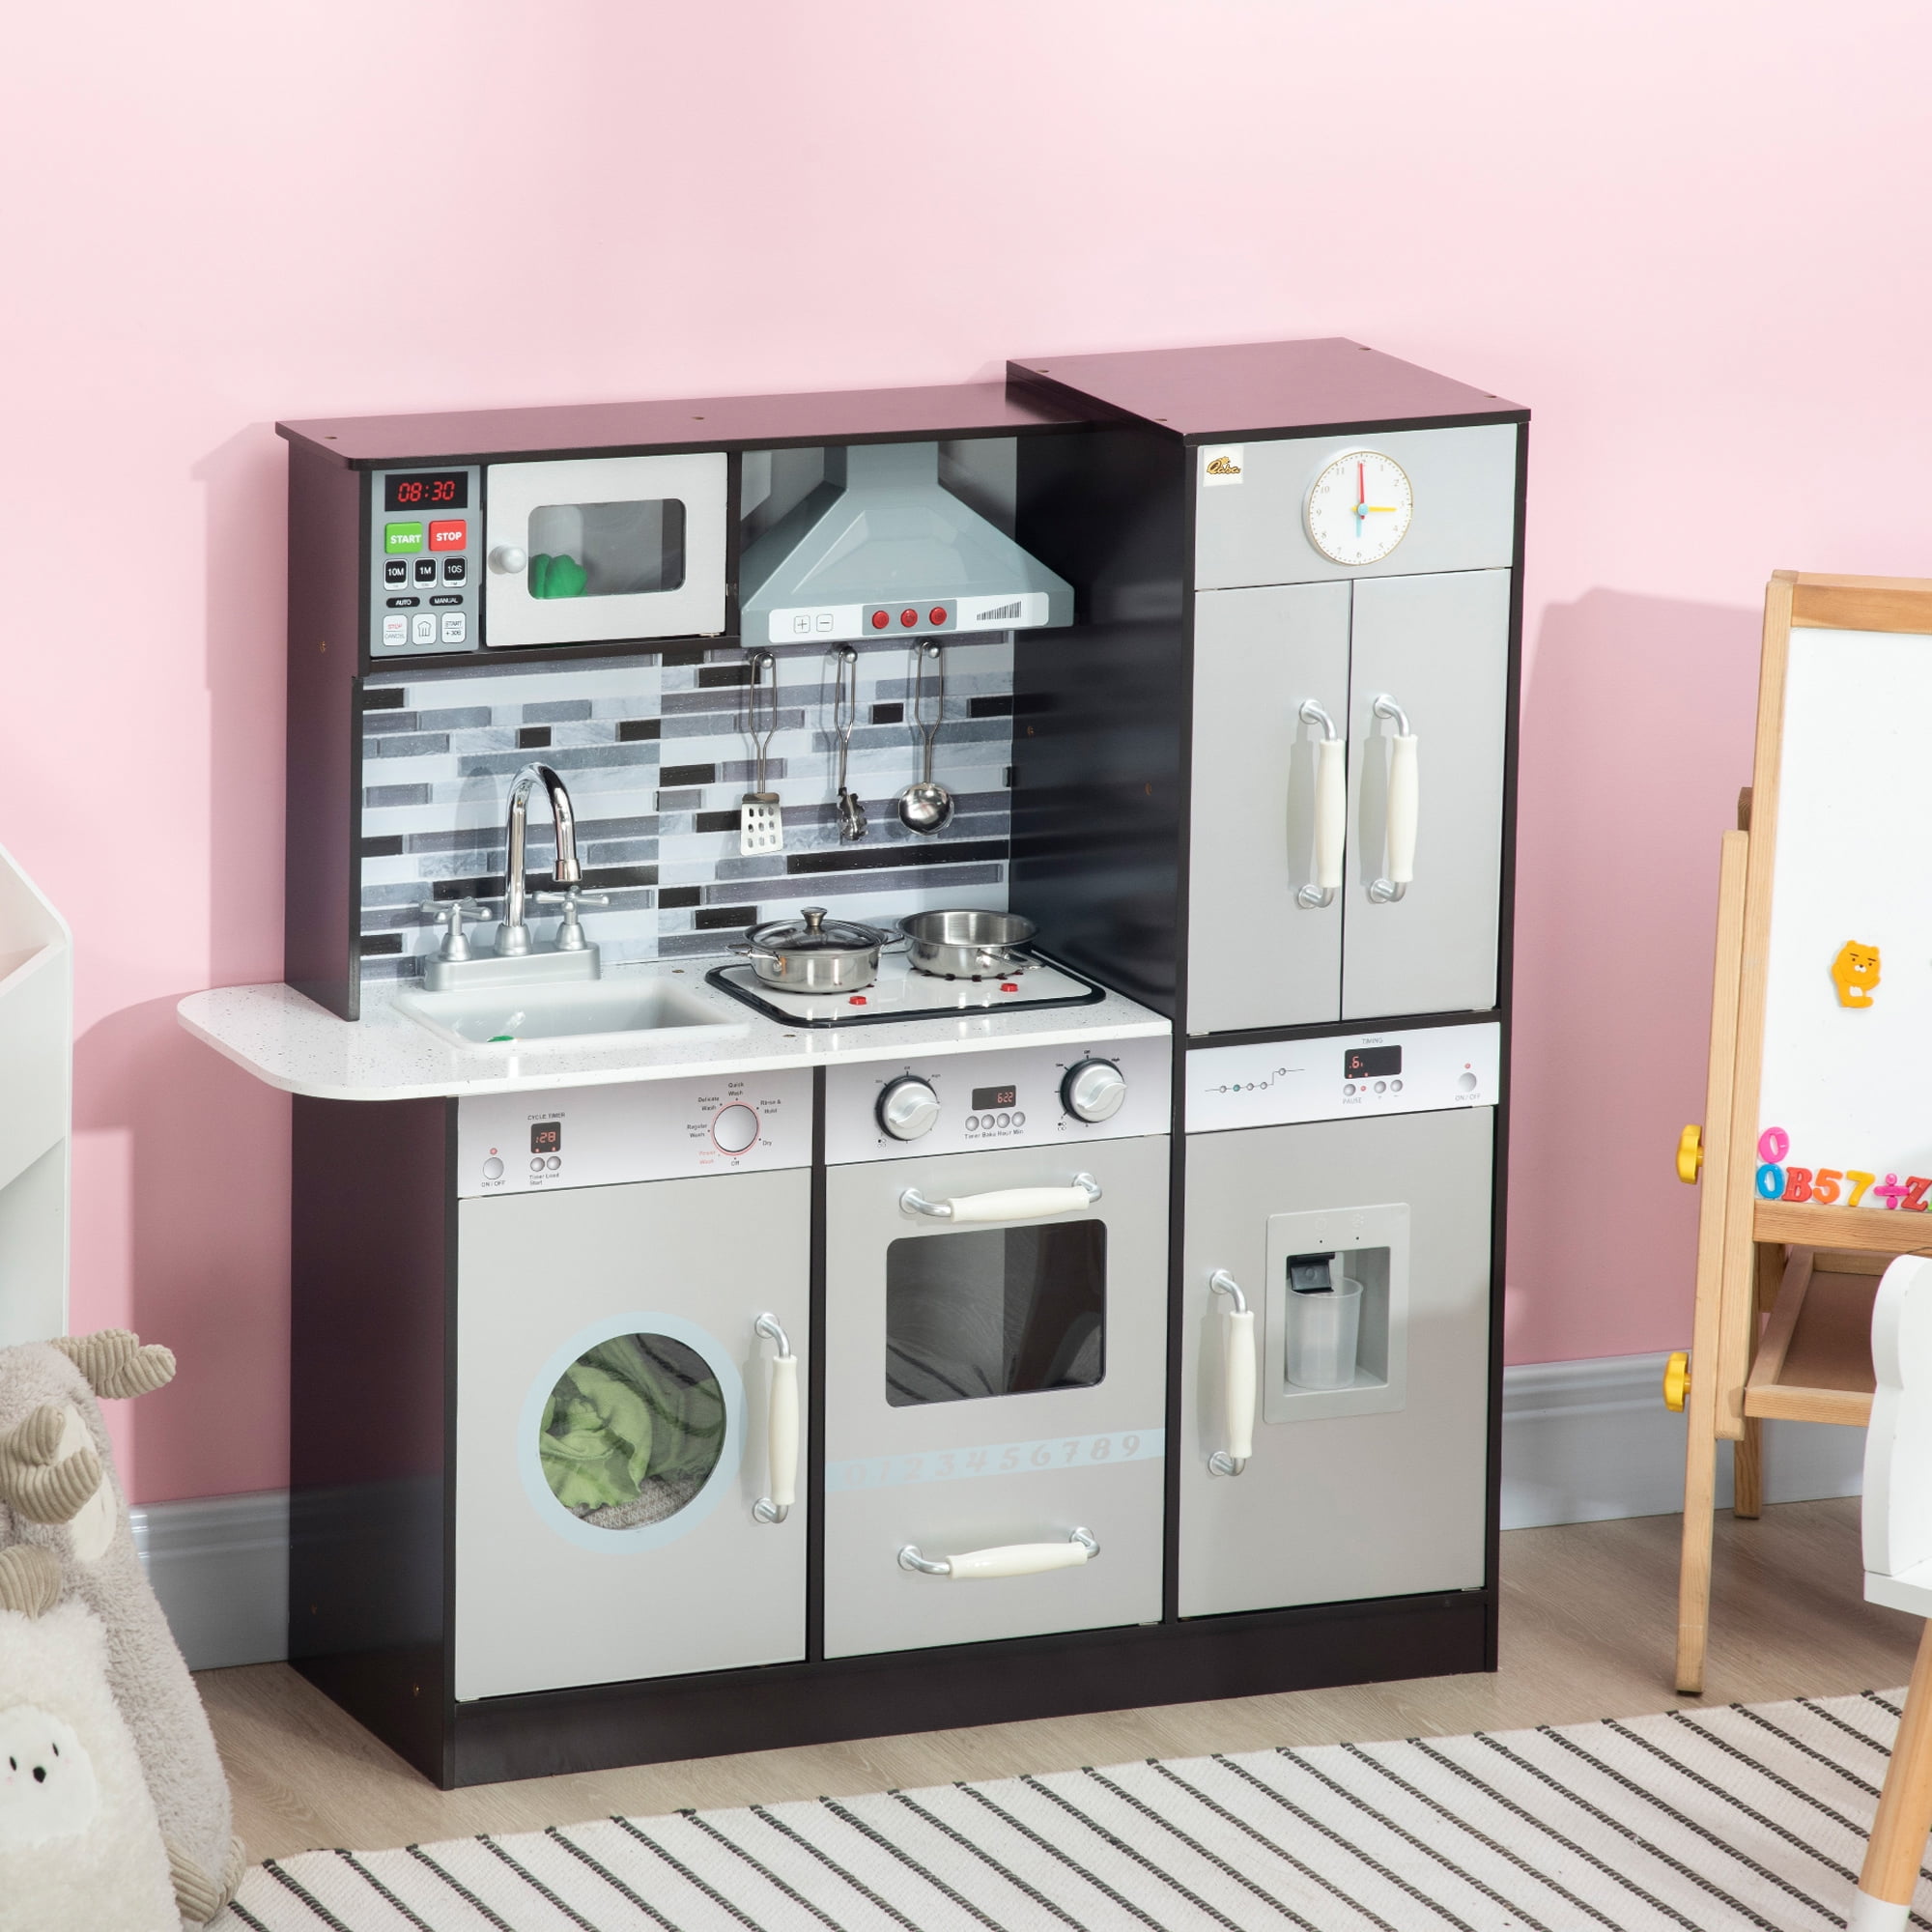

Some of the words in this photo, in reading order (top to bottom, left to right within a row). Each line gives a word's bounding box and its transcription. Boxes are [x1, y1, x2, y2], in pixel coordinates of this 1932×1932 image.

[398, 481, 455, 502] 08:30
[390, 534, 422, 545] START
[436, 531, 463, 542] STOP
[387, 567, 405, 577] 10M
[419, 566, 432, 576] 1M
[447, 565, 462, 575] 10S
[998, 1093, 1013, 1104] 622
